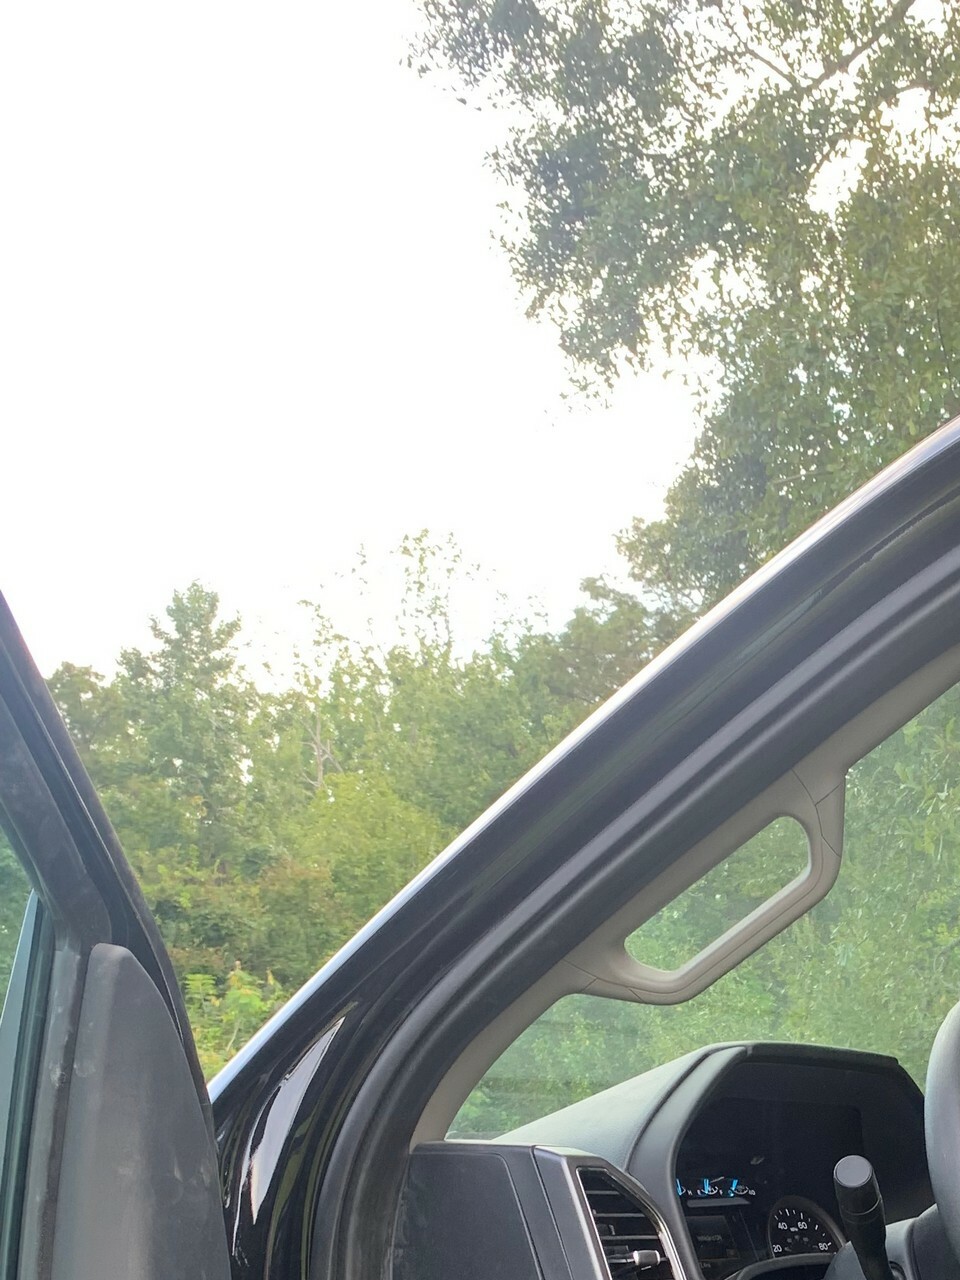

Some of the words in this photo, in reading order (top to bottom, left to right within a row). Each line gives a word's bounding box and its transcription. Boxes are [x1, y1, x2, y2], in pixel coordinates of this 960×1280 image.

[778, 1222, 788, 1230] 40
[797, 1221, 808, 1230] 60
[772, 1244, 782, 1253] 20
